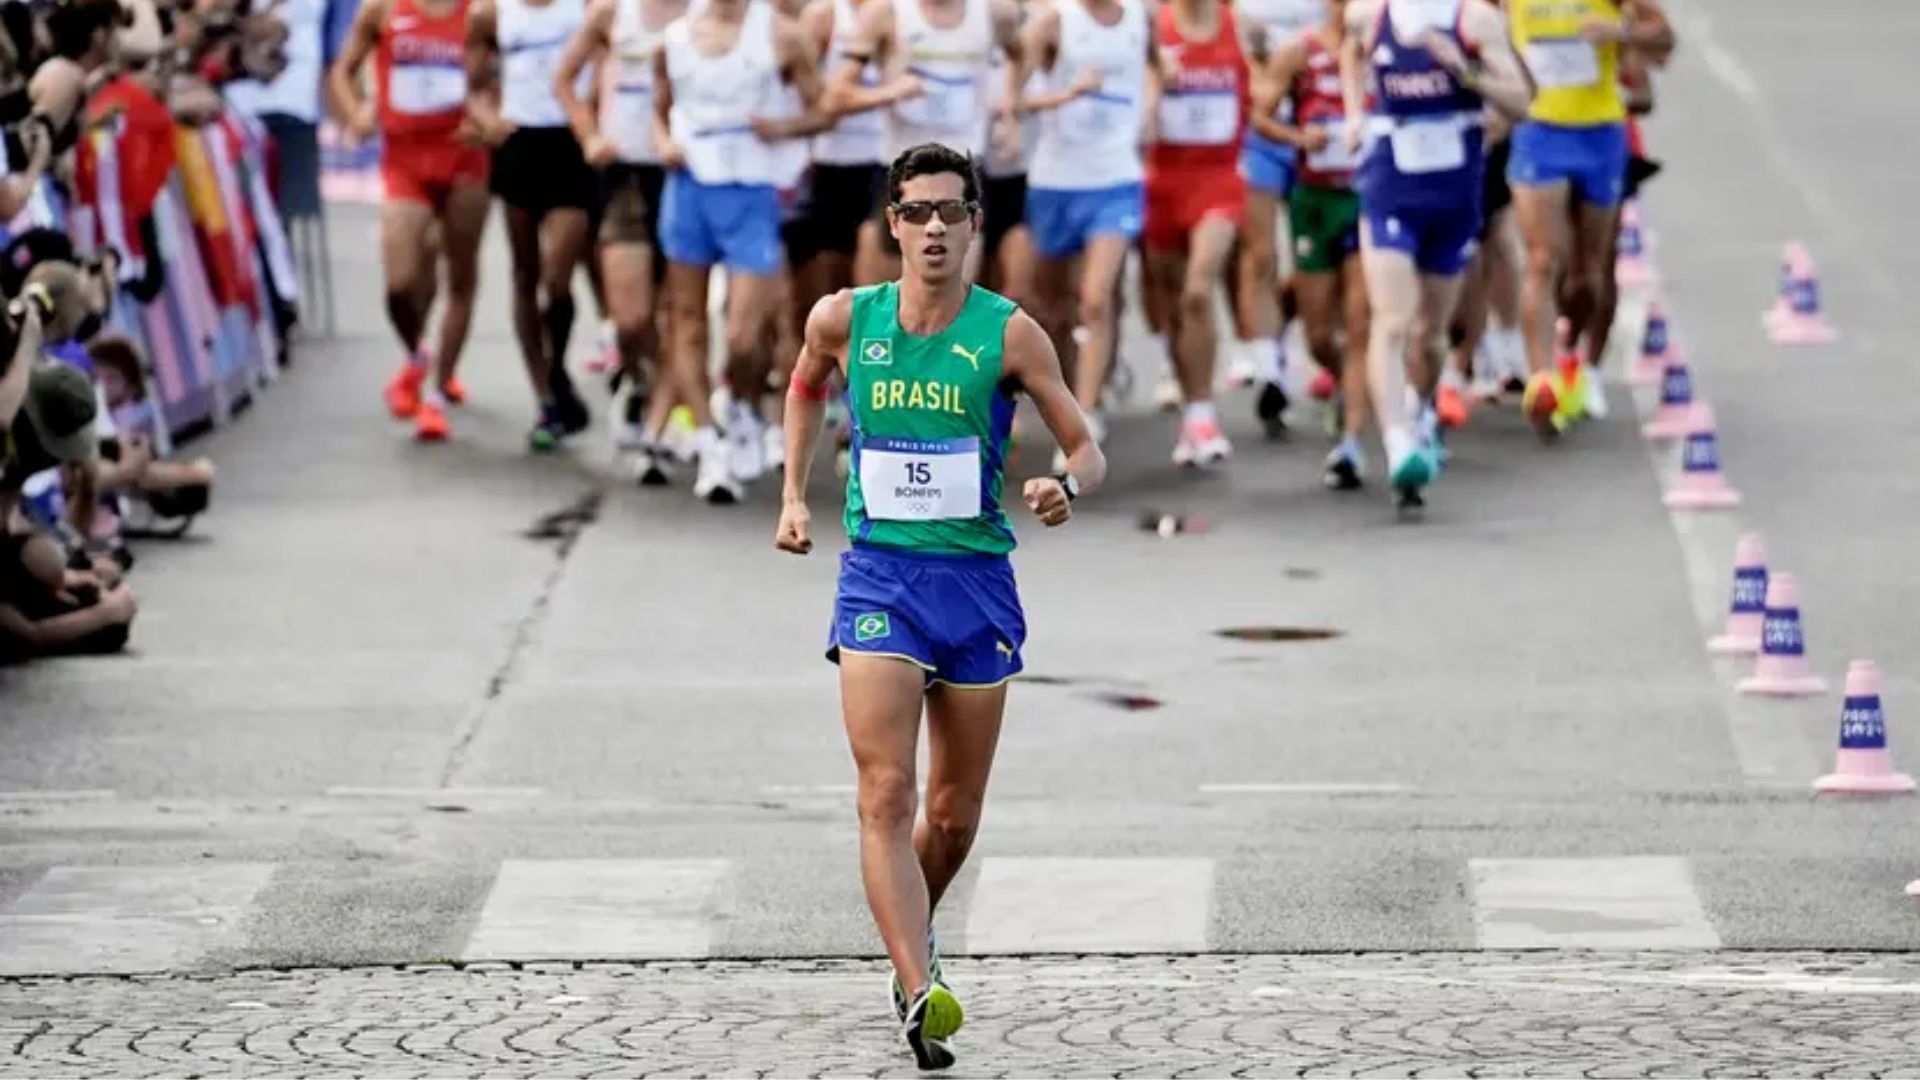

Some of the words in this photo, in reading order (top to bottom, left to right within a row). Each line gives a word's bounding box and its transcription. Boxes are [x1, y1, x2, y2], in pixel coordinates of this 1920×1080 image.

[871, 380, 966, 415] BRASIL
[888, 439, 919, 451] PARIS
[904, 462, 932, 485] 15
[894, 486, 942, 499] BONFIM
